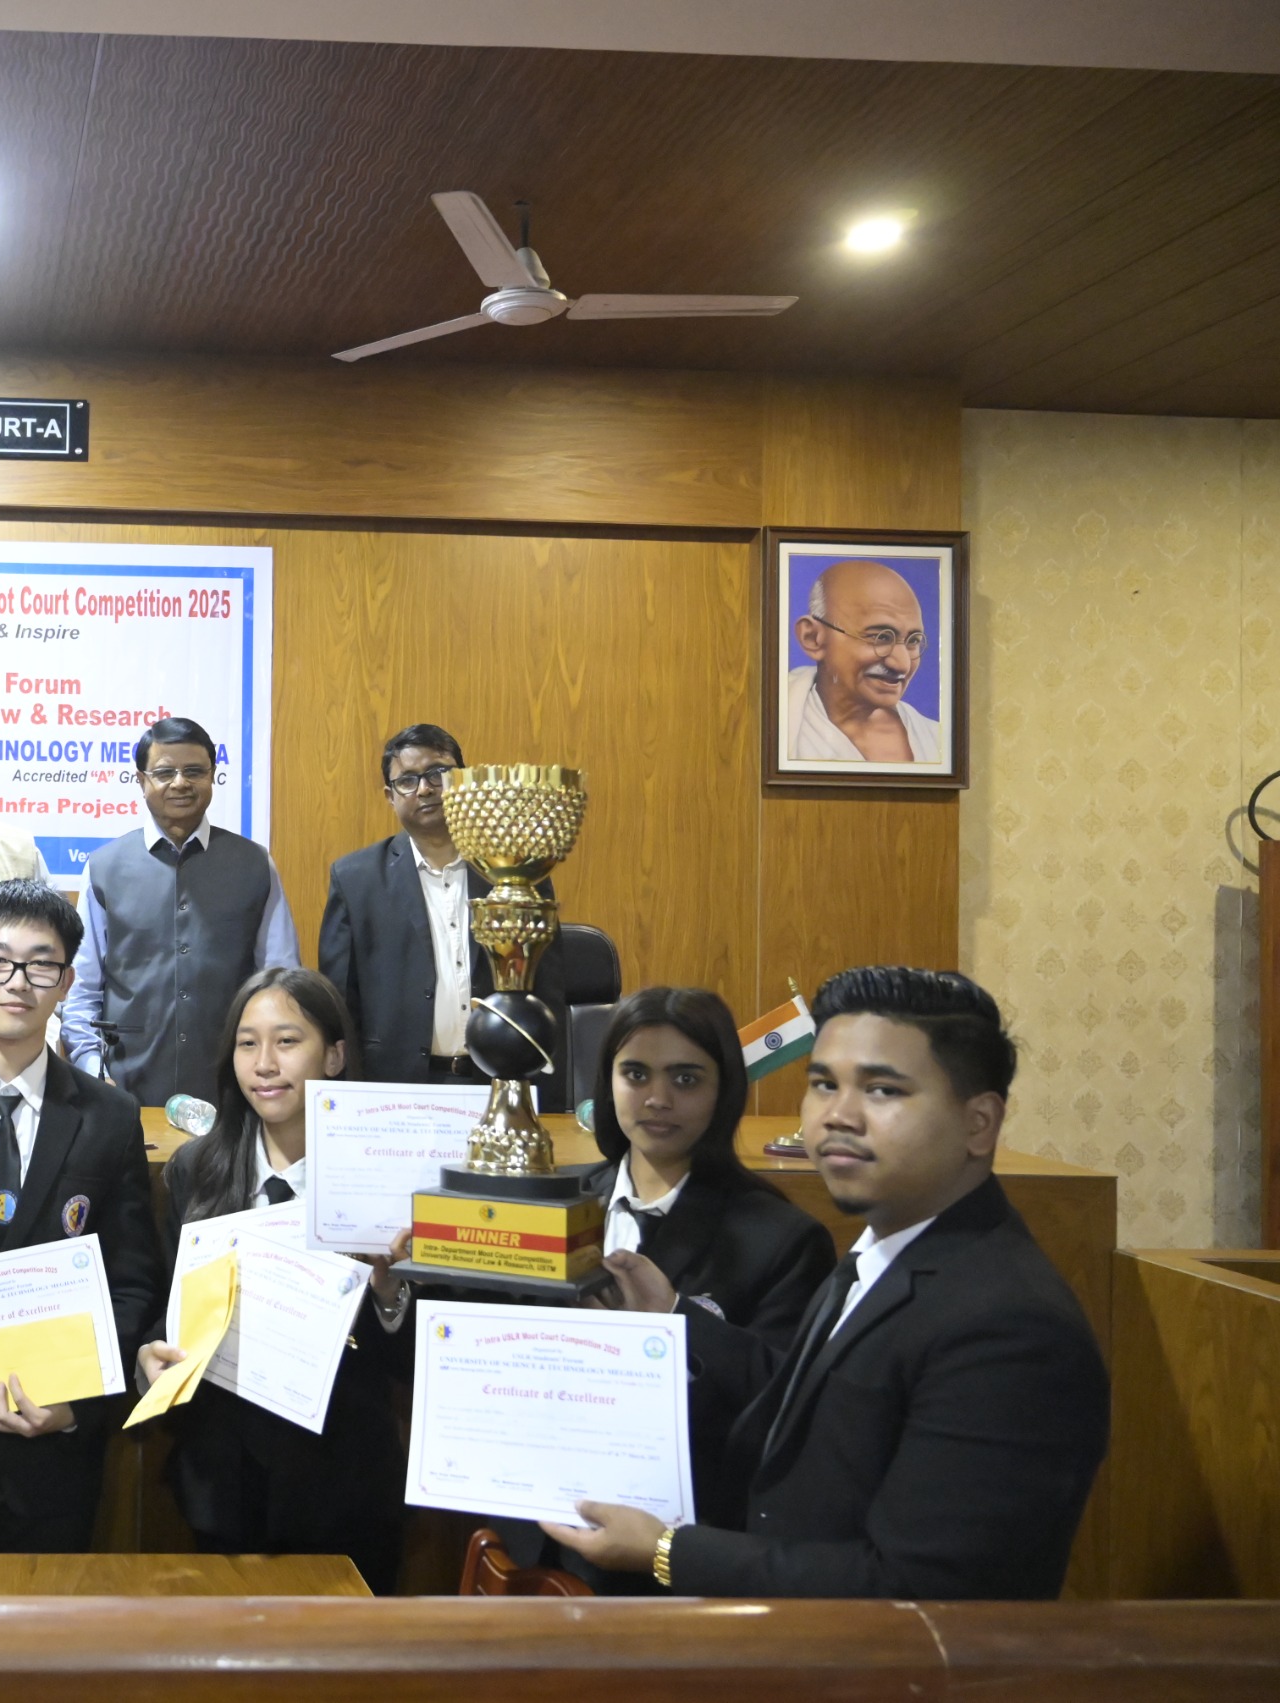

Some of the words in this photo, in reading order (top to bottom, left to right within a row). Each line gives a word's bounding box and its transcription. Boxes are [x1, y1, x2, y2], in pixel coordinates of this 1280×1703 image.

[20, 585, 70, 616] Court
[75, 587, 183, 624] Competition
[188, 588, 231, 619] 2025
[15, 624, 80, 643] Inspire
[5, 672, 82, 695] Forum
[31, 704, 48, 725] &
[57, 704, 172, 728] Research
[12, 769, 88, 783] Accredited
[57, 798, 139, 819] Project
[431, 1103, 466, 1115] Competition
[364, 1146, 413, 1157] Certificate
[429, 1149, 467, 1159] Excelle
[456, 1226, 521, 1248] WINNER
[420, 1251, 451, 1261] University
[452, 1254, 474, 1263] School
[536, 1264, 557, 1272] USTM
[441, 1245, 477, 1256] Department
[478, 1249, 494, 1257] Moot
[494, 1250, 513, 1260] Court
[513, 1253, 554, 1265] Competition
[7, 1311, 15, 1320] of
[17, 1303, 61, 1317] Excellence
[484, 1335, 501, 1344] Intra
[502, 1332, 520, 1342] USLR
[521, 1332, 538, 1340] Moot
[540, 1331, 559, 1341] Court
[560, 1334, 602, 1350] Competition
[603, 1343, 621, 1356] 2025
[481, 1383, 540, 1398] Certificate
[543, 1389, 553, 1400] of
[557, 1390, 617, 1405] Excellence
